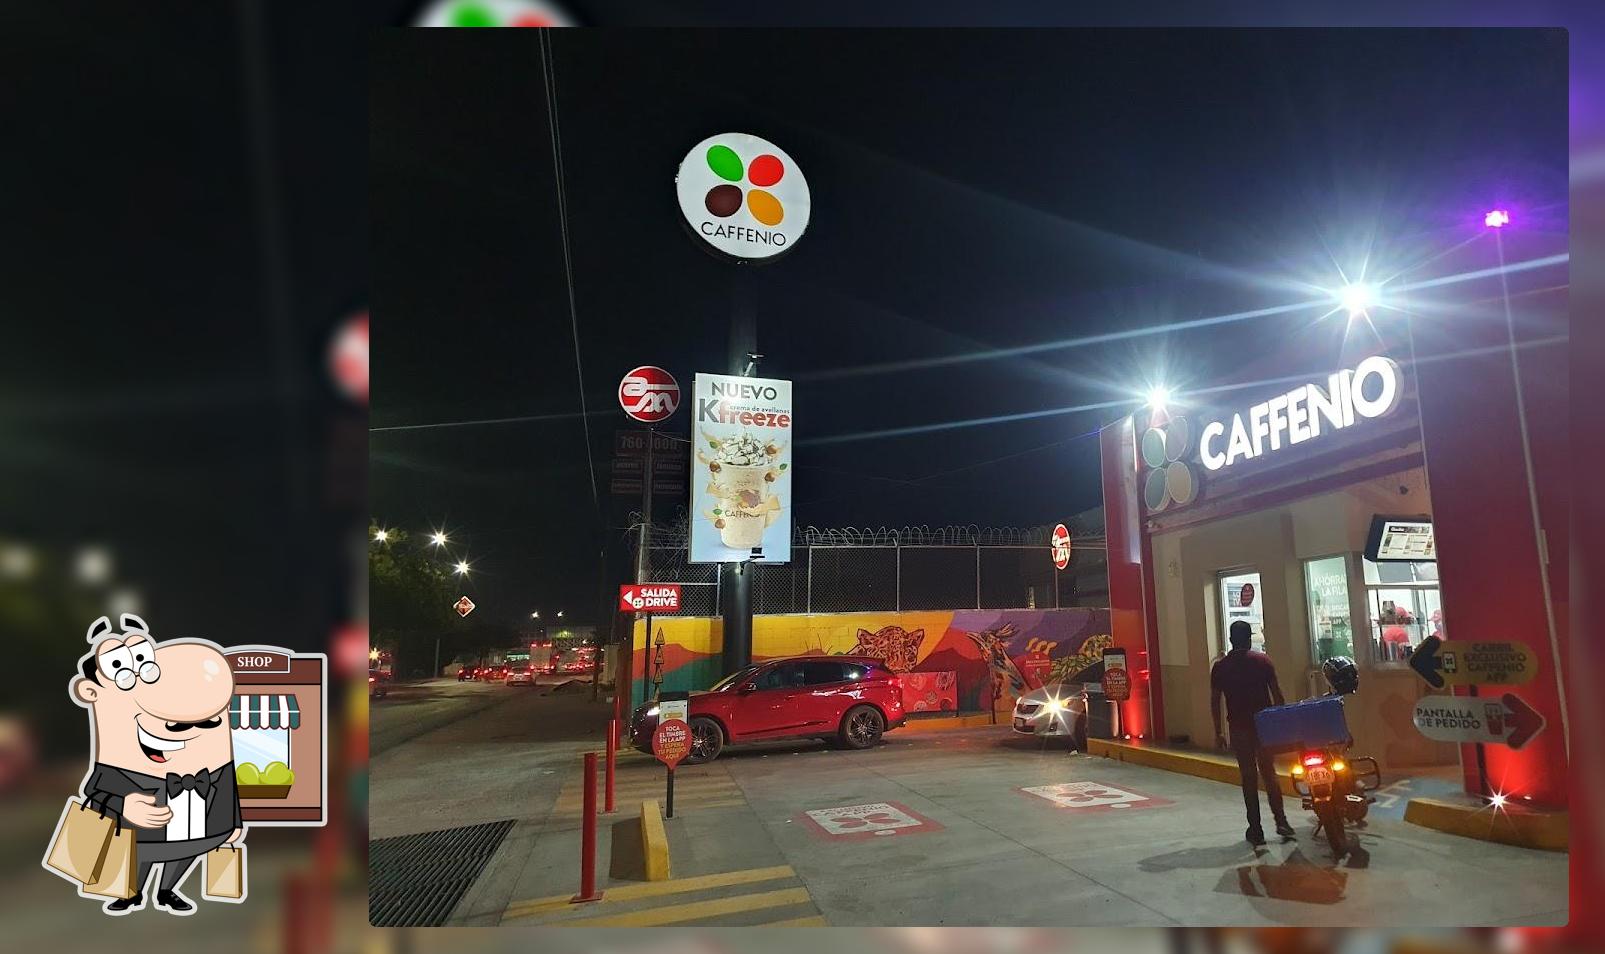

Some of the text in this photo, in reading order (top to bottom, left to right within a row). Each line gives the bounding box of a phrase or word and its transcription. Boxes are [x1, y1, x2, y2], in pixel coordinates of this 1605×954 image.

[701, 221, 786, 246] CAFFENIO
[711, 382, 777, 401] NUEVO
[752, 404, 760, 412] de
[761, 405, 790, 415] avellanas
[1199, 355, 1400, 470] CAFFENIO
[640, 588, 678, 598] SALIDA
[645, 597, 678, 607] DRIVE
[1464, 652, 1527, 662] EXCLUSIVO
[1468, 662, 1525, 672] CAFFENIO
[1417, 708, 1474, 719] PANTALLA
[1418, 718, 1481, 729] DE PEDIDO
